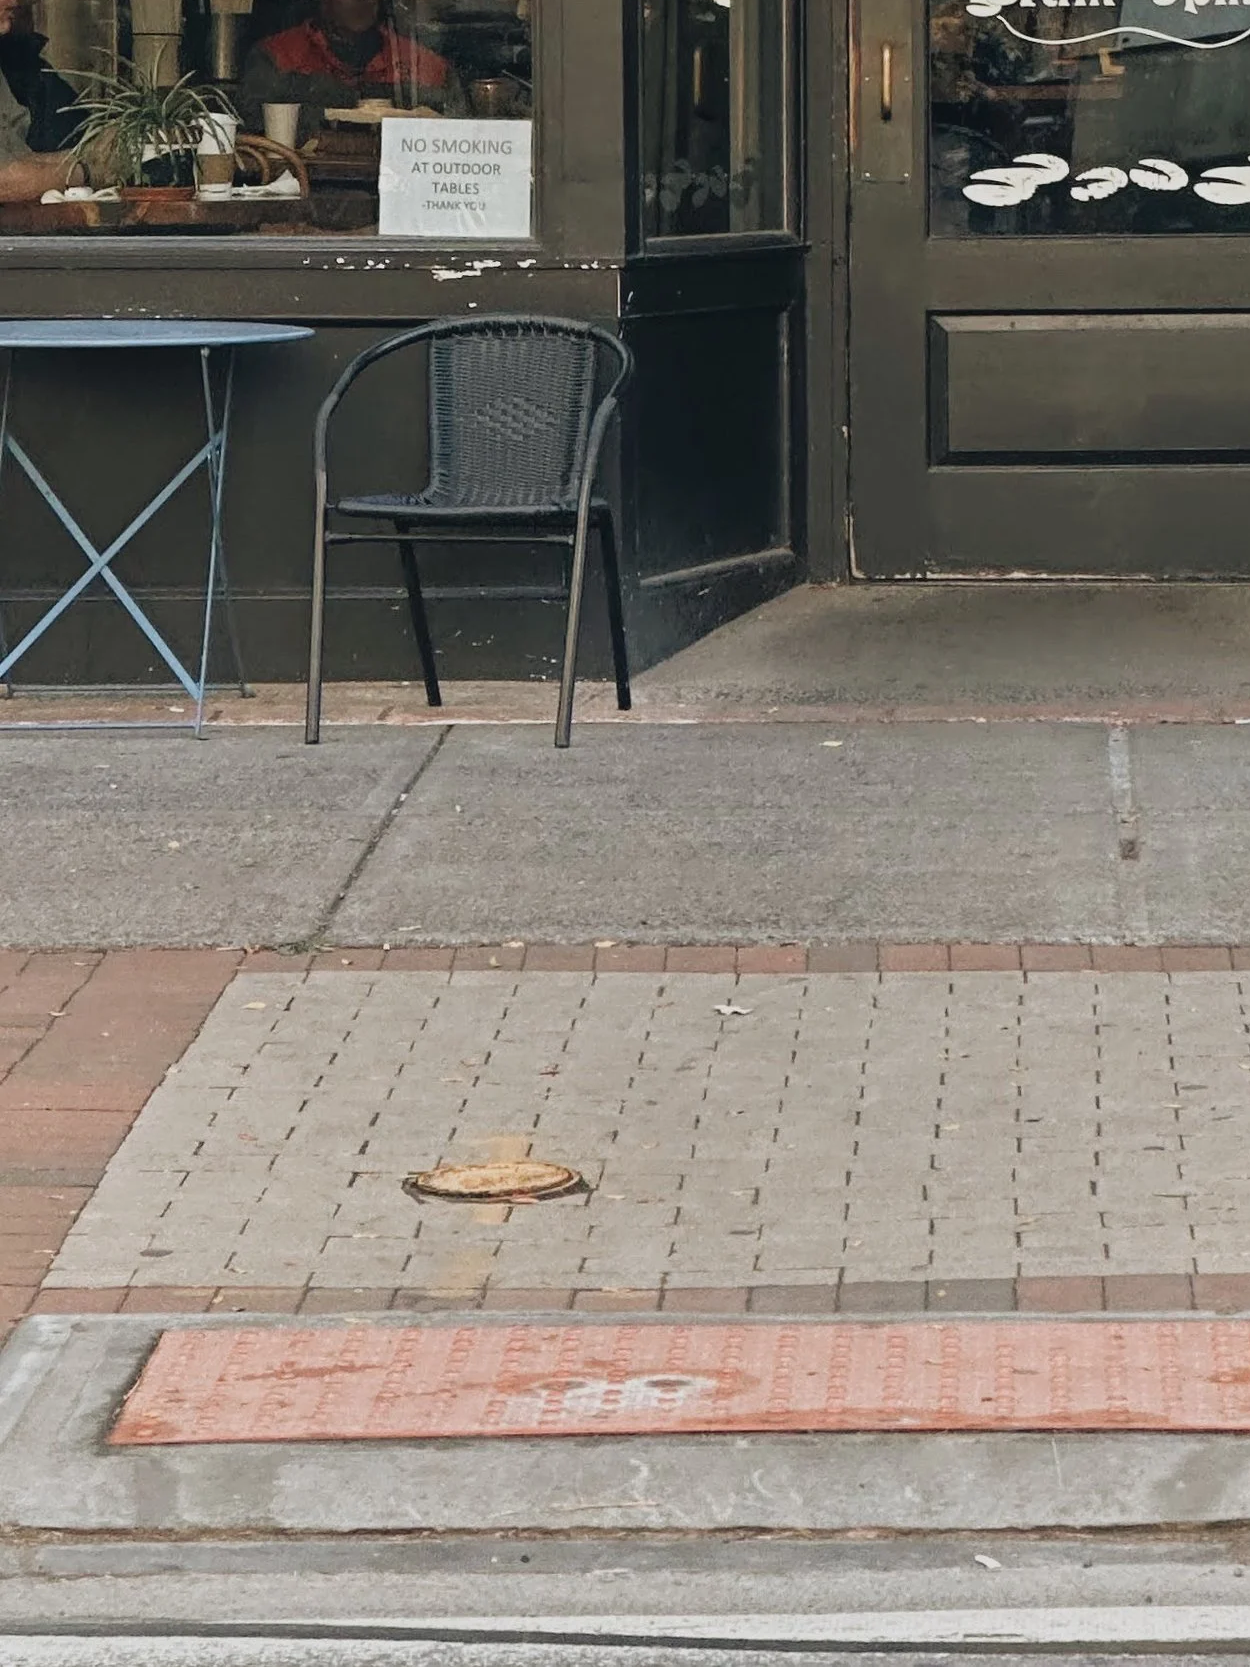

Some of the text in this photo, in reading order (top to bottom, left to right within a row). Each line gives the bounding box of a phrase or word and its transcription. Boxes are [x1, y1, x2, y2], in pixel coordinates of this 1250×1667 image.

[401, 138, 513, 155] NO SMOKING
[411, 162, 501, 175] AT OUTDOOR
[432, 182, 480, 195] TABLES
[464, 201, 486, 211] YOU
